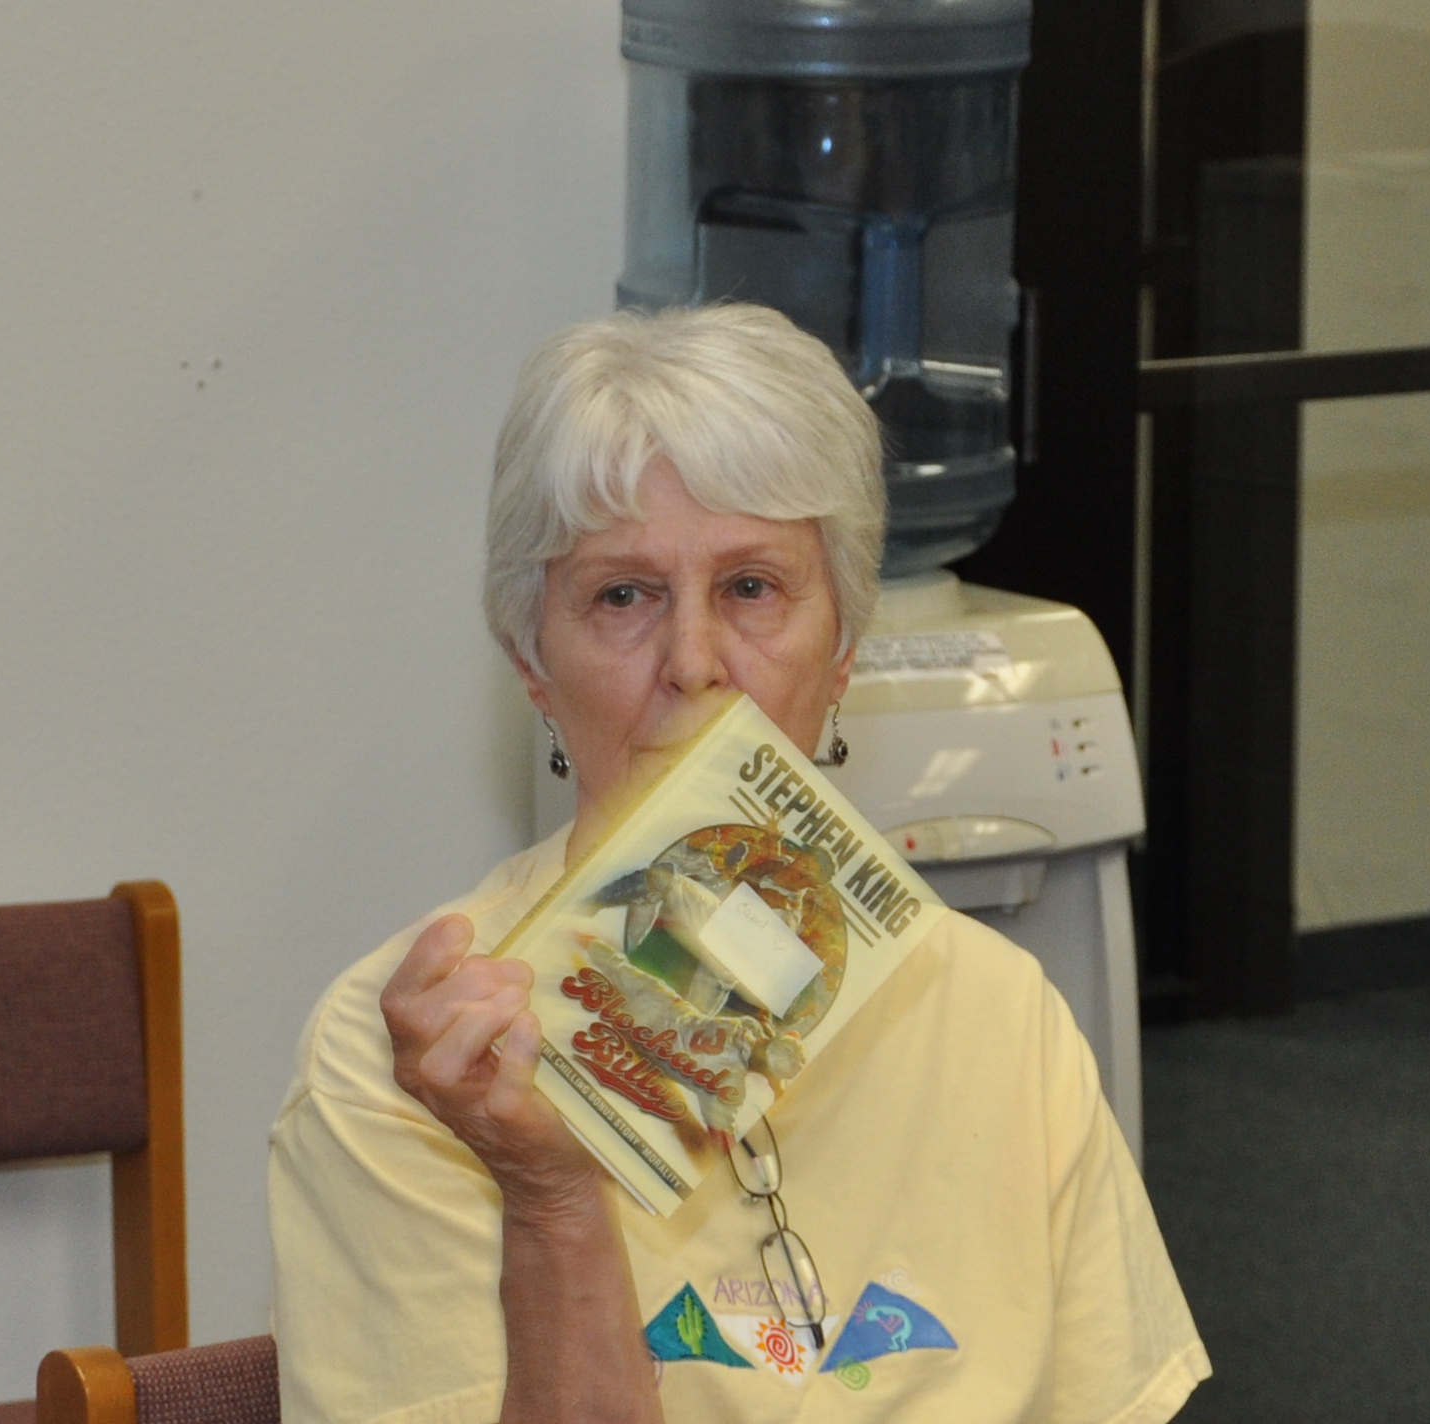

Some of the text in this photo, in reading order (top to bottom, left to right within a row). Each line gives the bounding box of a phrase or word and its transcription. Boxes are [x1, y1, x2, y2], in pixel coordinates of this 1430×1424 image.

[739, 743, 923, 940] STEPHEN KING
[560, 966, 746, 1104] Blockade
[572, 1021, 687, 1121] Billy
[541, 1042, 555, 1061] THE
[554, 1056, 591, 1094] CHILLING
[588, 1092, 615, 1122] BONUS
[614, 1118, 639, 1146] STORY
[713, 1276, 830, 1307] ARIZONA
